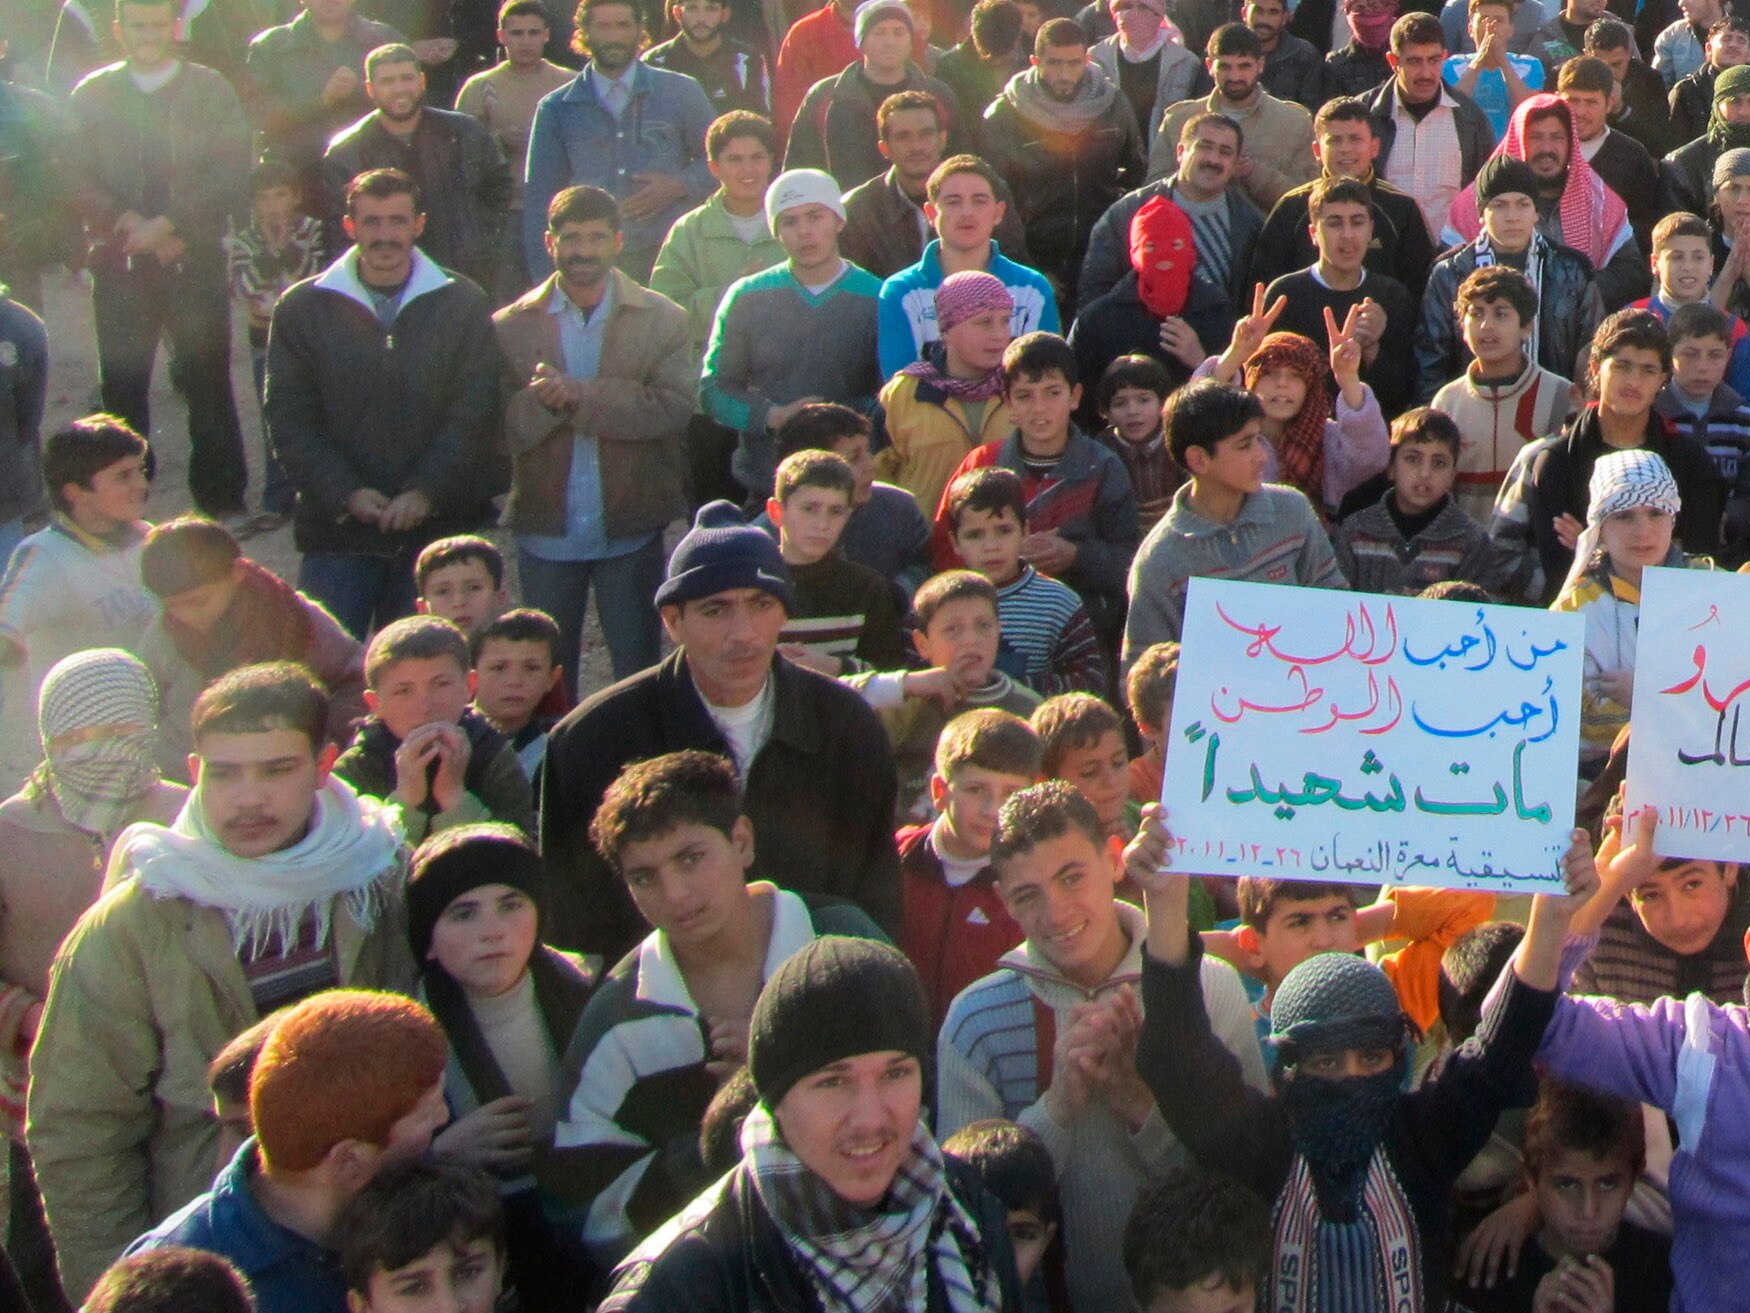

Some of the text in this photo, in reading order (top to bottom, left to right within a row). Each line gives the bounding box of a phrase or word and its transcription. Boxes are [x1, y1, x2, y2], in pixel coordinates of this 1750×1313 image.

[1216, 599, 1568, 671] من أحب الله
[1210, 666, 1559, 743] أحب الوطن
[1413, 738, 1553, 825] مات
[1310, 830, 1390, 874] النعمان
[1394, 841, 1440, 881] معرة
[1448, 835, 1565, 888] تنسيقية
